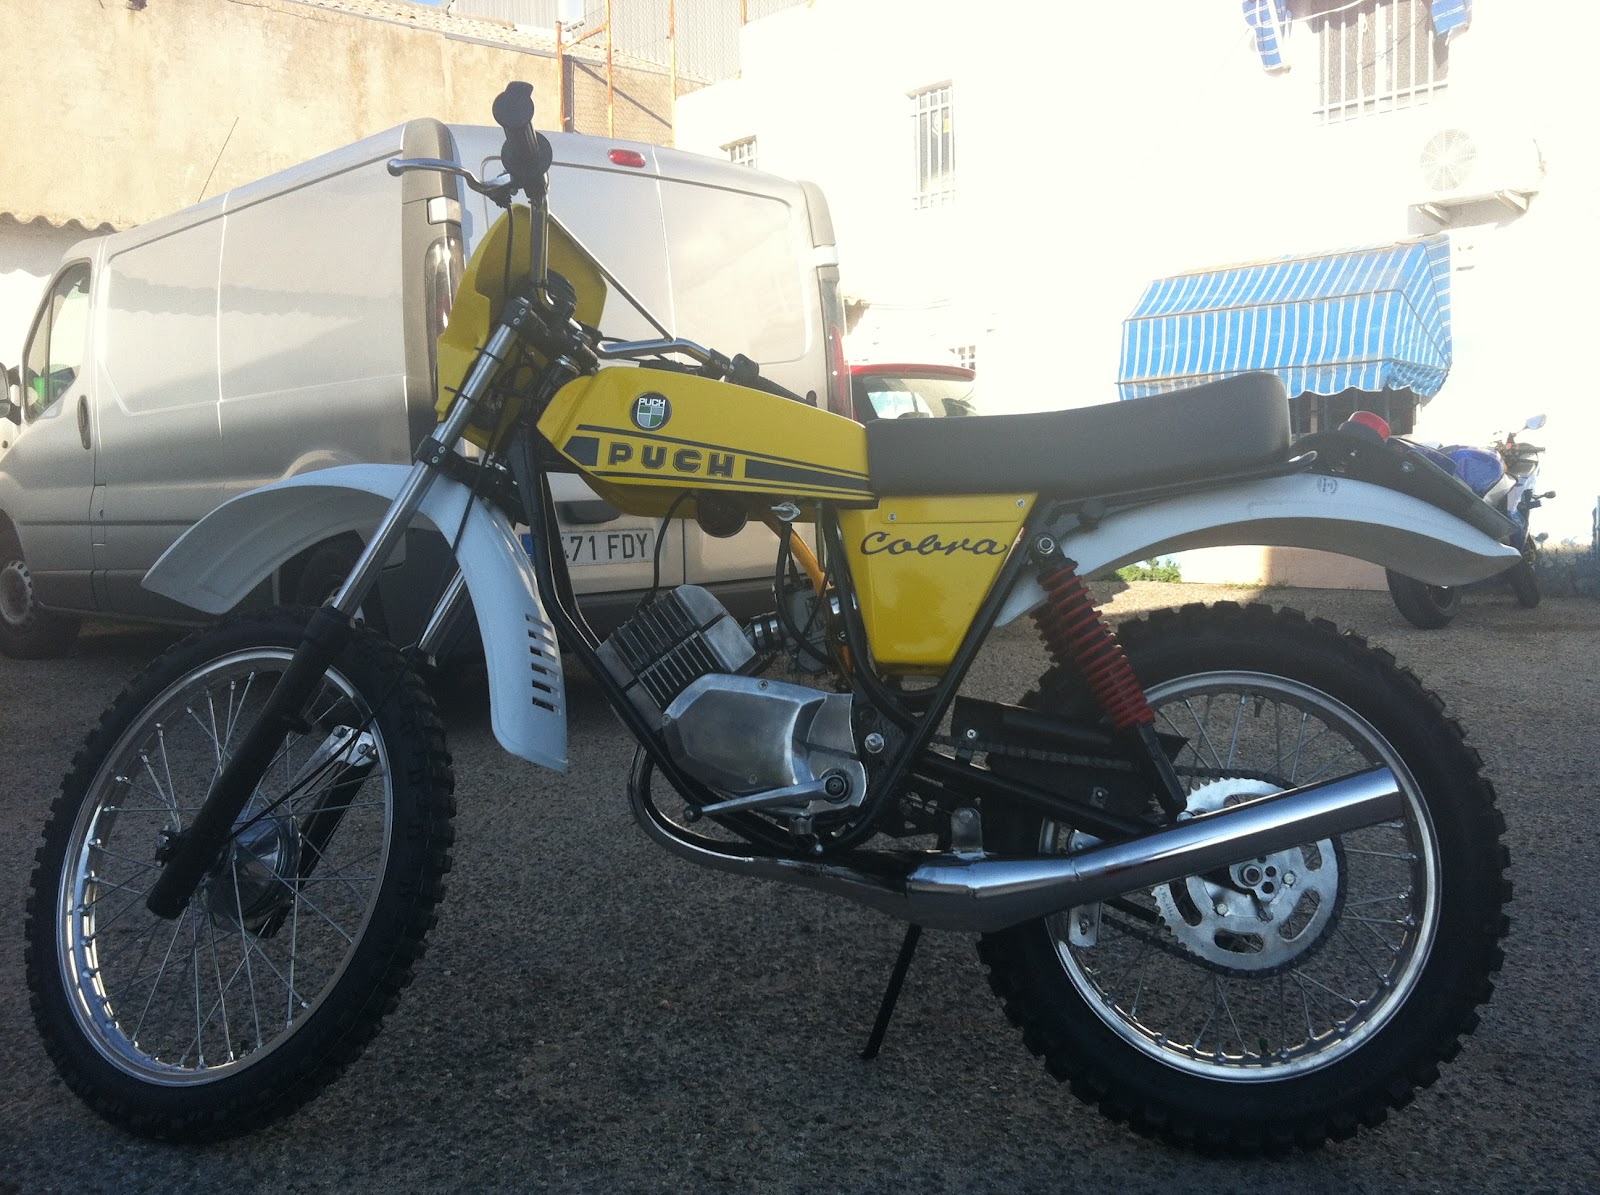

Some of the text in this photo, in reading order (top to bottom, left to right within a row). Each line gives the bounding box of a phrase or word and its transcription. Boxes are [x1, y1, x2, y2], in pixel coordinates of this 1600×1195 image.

[638, 397, 666, 407] PUCH
[608, 442, 735, 478] PUCH
[561, 533, 648, 562] 71 FDY
[860, 531, 1009, 556] Cobra
